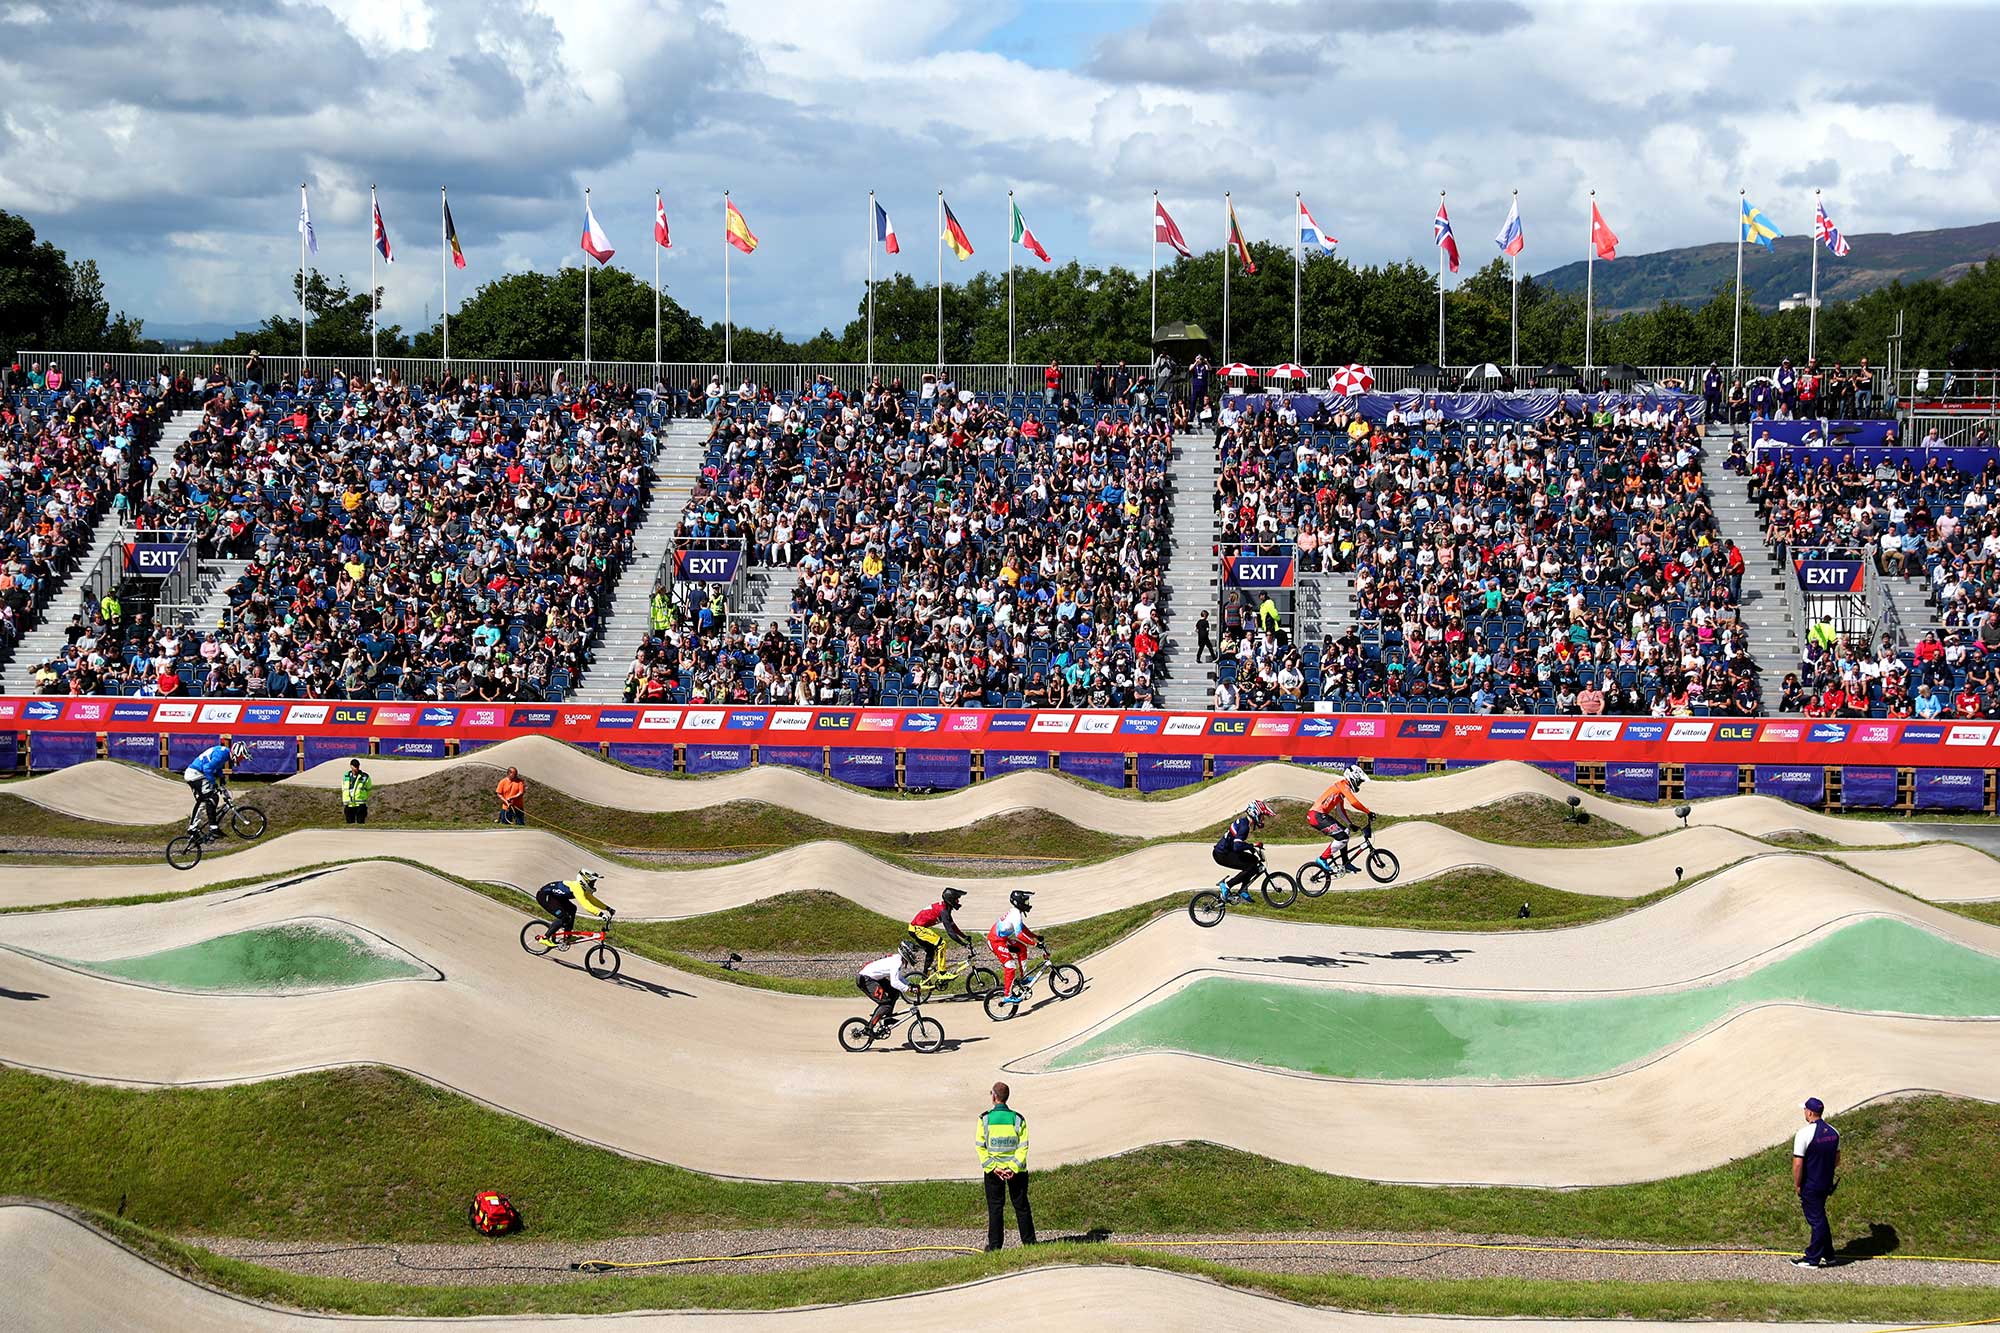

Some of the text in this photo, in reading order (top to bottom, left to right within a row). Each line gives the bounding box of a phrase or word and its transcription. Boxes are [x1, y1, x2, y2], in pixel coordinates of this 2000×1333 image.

[140, 551, 178, 566] EXIT
[690, 559, 728, 574] EXIT
[1240, 565, 1278, 580] EXIT
[1807, 568, 1848, 584] EXIT
[299, 711, 323, 719] vittoria
[781, 717, 806, 725] vittoria
[1176, 722, 1201, 730] vittoria
[1682, 728, 1706, 736] vittoria
